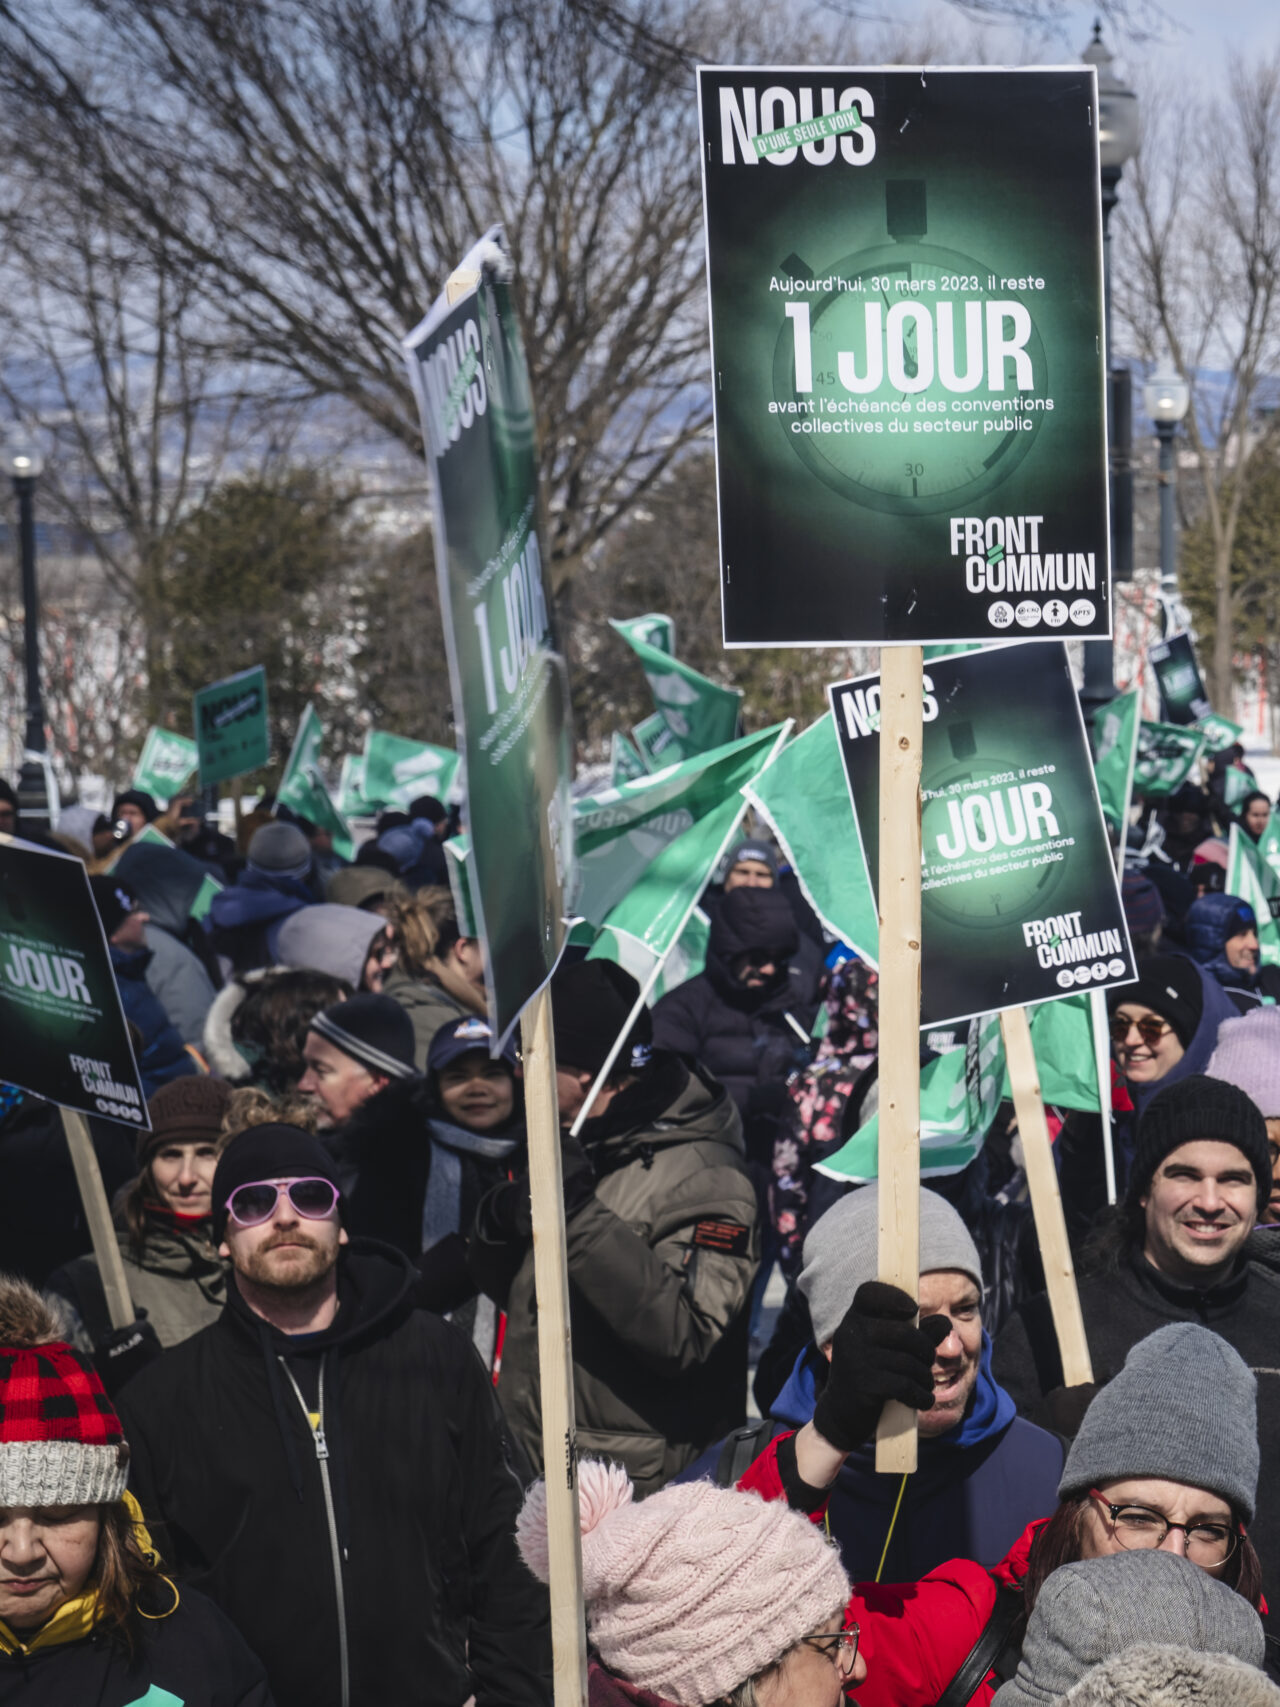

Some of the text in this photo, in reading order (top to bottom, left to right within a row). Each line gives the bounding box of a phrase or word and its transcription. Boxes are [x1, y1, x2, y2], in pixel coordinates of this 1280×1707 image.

[718, 86, 877, 167] NOUS
[757, 111, 857, 154] D'UNE SEULE VOIX
[769, 275, 1045, 295] Aujourd'hui, 30 mars 2023, il reste
[785, 300, 1035, 394] 1 JOUR
[816, 372, 836, 385] 45
[768, 396, 1054, 414] avant l'échéance des conventions
[791, 417, 1032, 435] collectives du secteur public
[904, 463, 924, 477] 30
[950, 516, 1044, 556] FRONT
[965, 553, 1096, 594] COMMUN
[841, 674, 939, 740] NOS
[949, 784, 961, 794] 30
[963, 779, 988, 790] mars
[1027, 764, 1056, 777] reste
[936, 782, 1061, 859] JOUR
[974, 868, 988, 879] du
[990, 858, 1030, 875] secteur
[1032, 852, 1064, 868] public
[1011, 837, 1075, 858] conventions
[1022, 911, 1082, 948] FRONT
[1037, 928, 1122, 970] COMMUN
[5, 943, 92, 1005] JOUR
